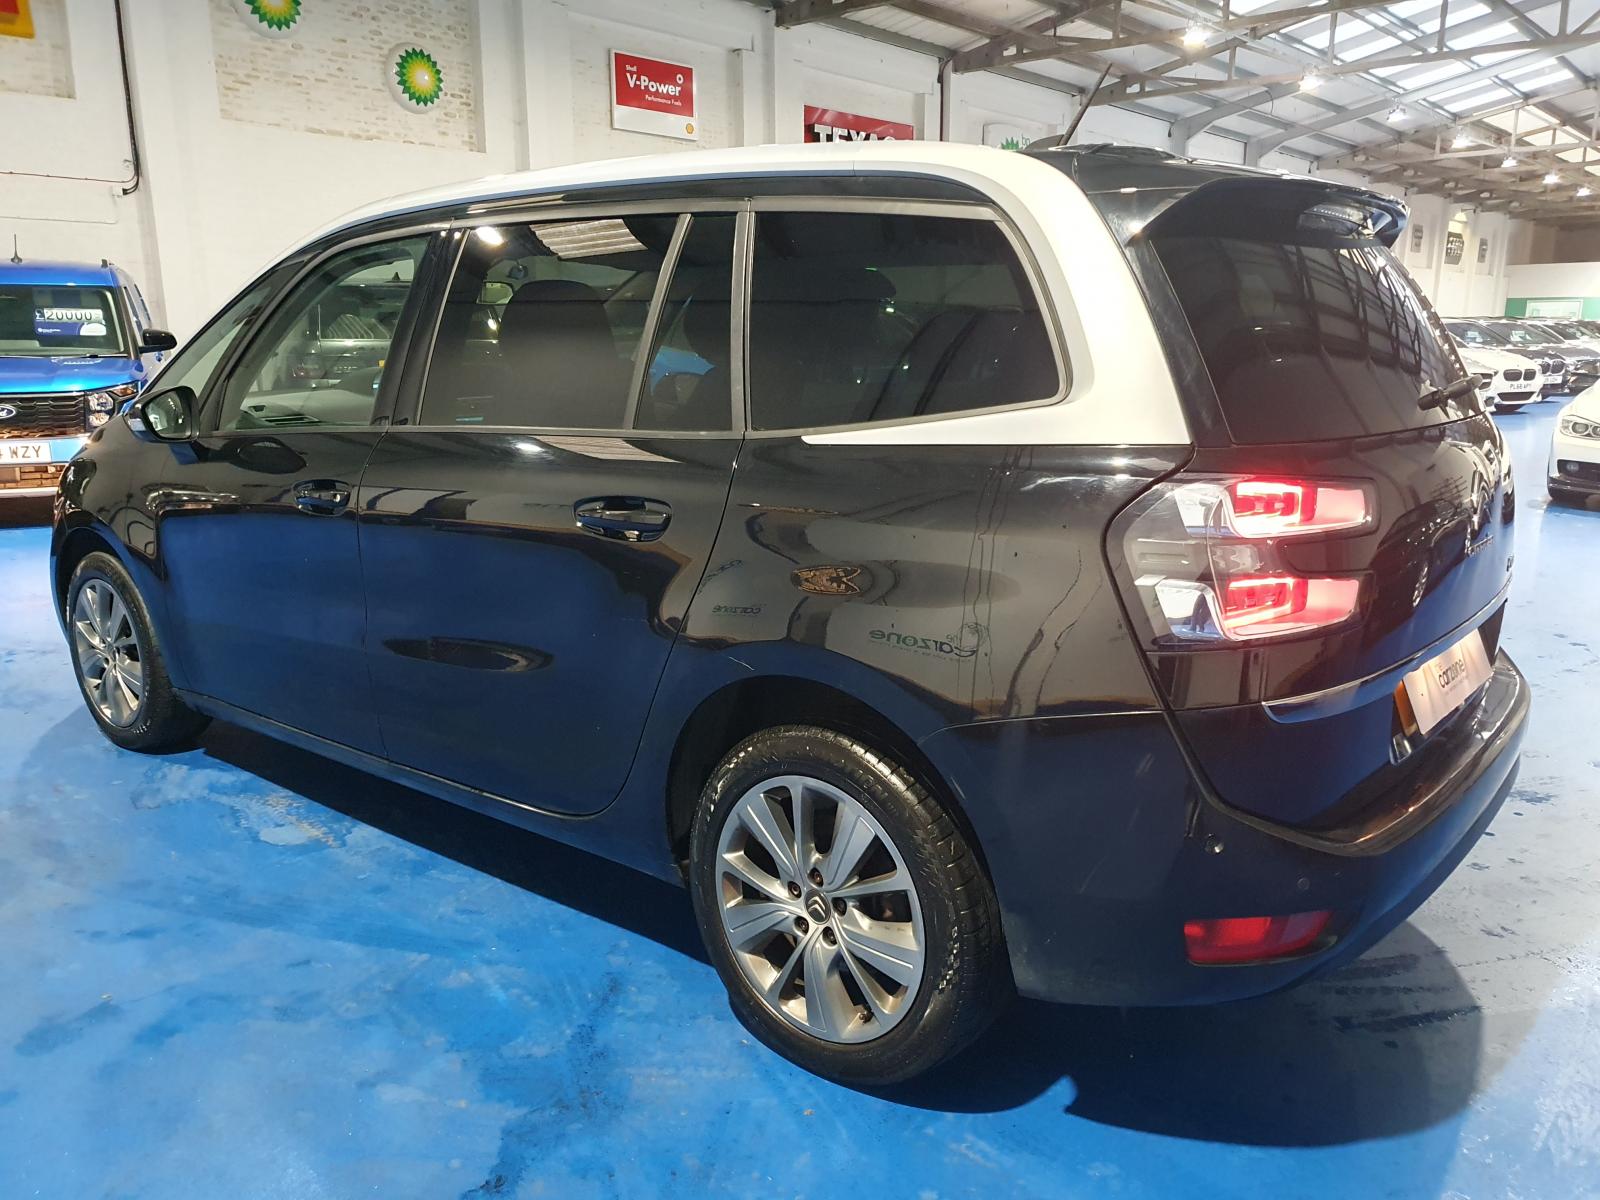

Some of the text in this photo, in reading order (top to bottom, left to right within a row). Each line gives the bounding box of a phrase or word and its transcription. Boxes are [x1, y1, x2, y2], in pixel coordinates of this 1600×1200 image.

[625, 64, 637, 72] Shell
[625, 72, 682, 96] V-Power
[645, 94, 671, 105] Performance
[9, 445, 41, 459] WZY
